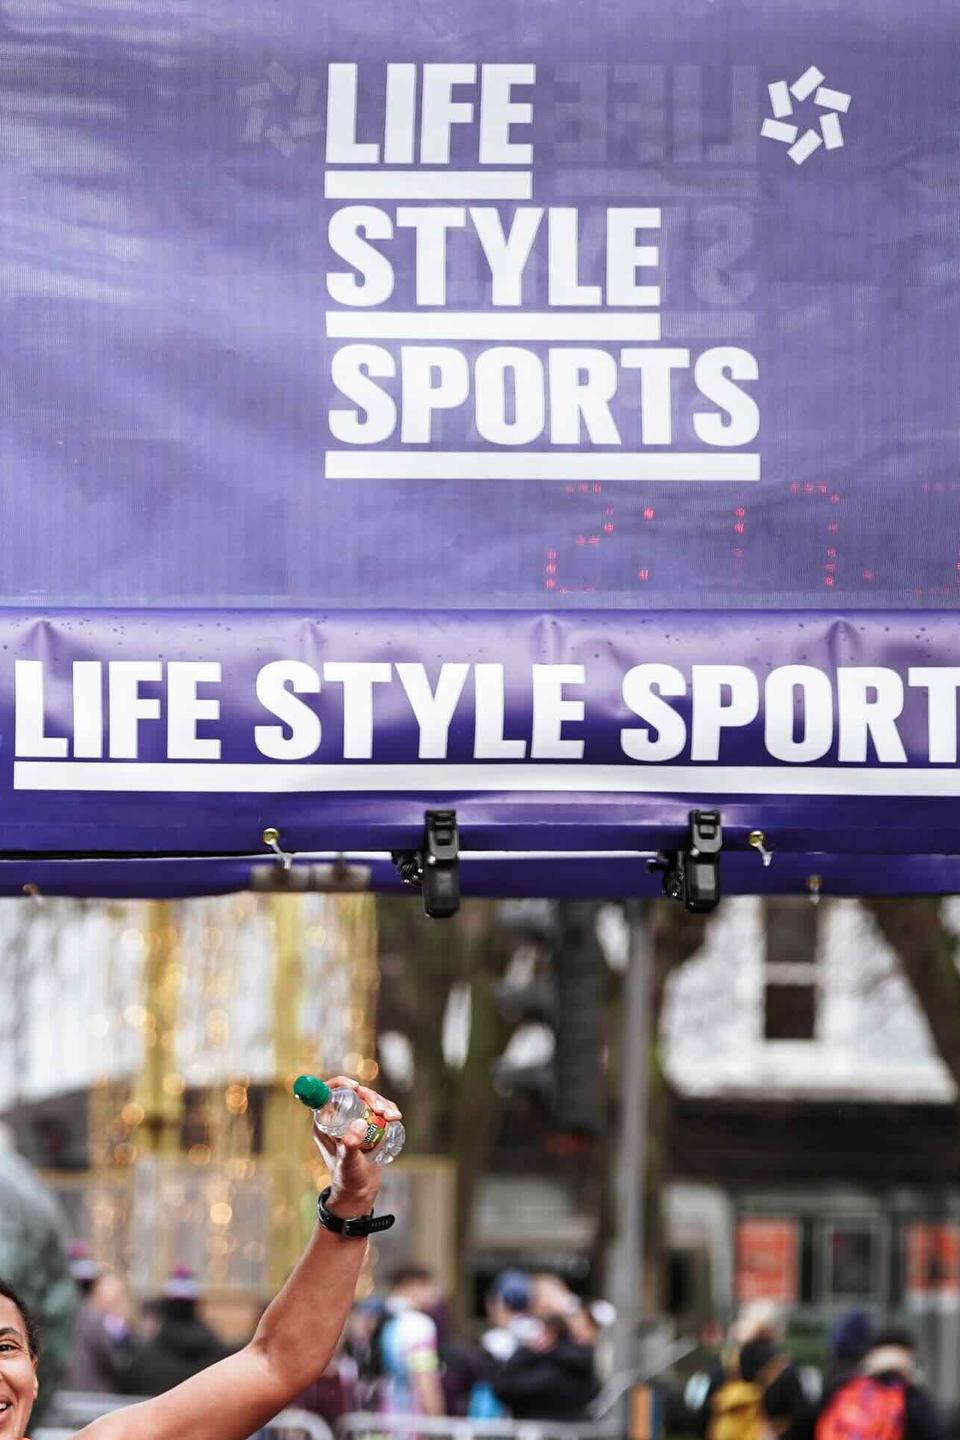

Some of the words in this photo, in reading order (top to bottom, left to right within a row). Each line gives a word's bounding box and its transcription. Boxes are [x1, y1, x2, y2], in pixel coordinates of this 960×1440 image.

[327, 63, 535, 164] LIFE
[326, 206, 661, 306] STYLE
[329, 345, 760, 446] SPORTS
[14, 661, 221, 758] LIFE
[256, 661, 585, 760] STYLE
[622, 664, 960, 763] SPORT
